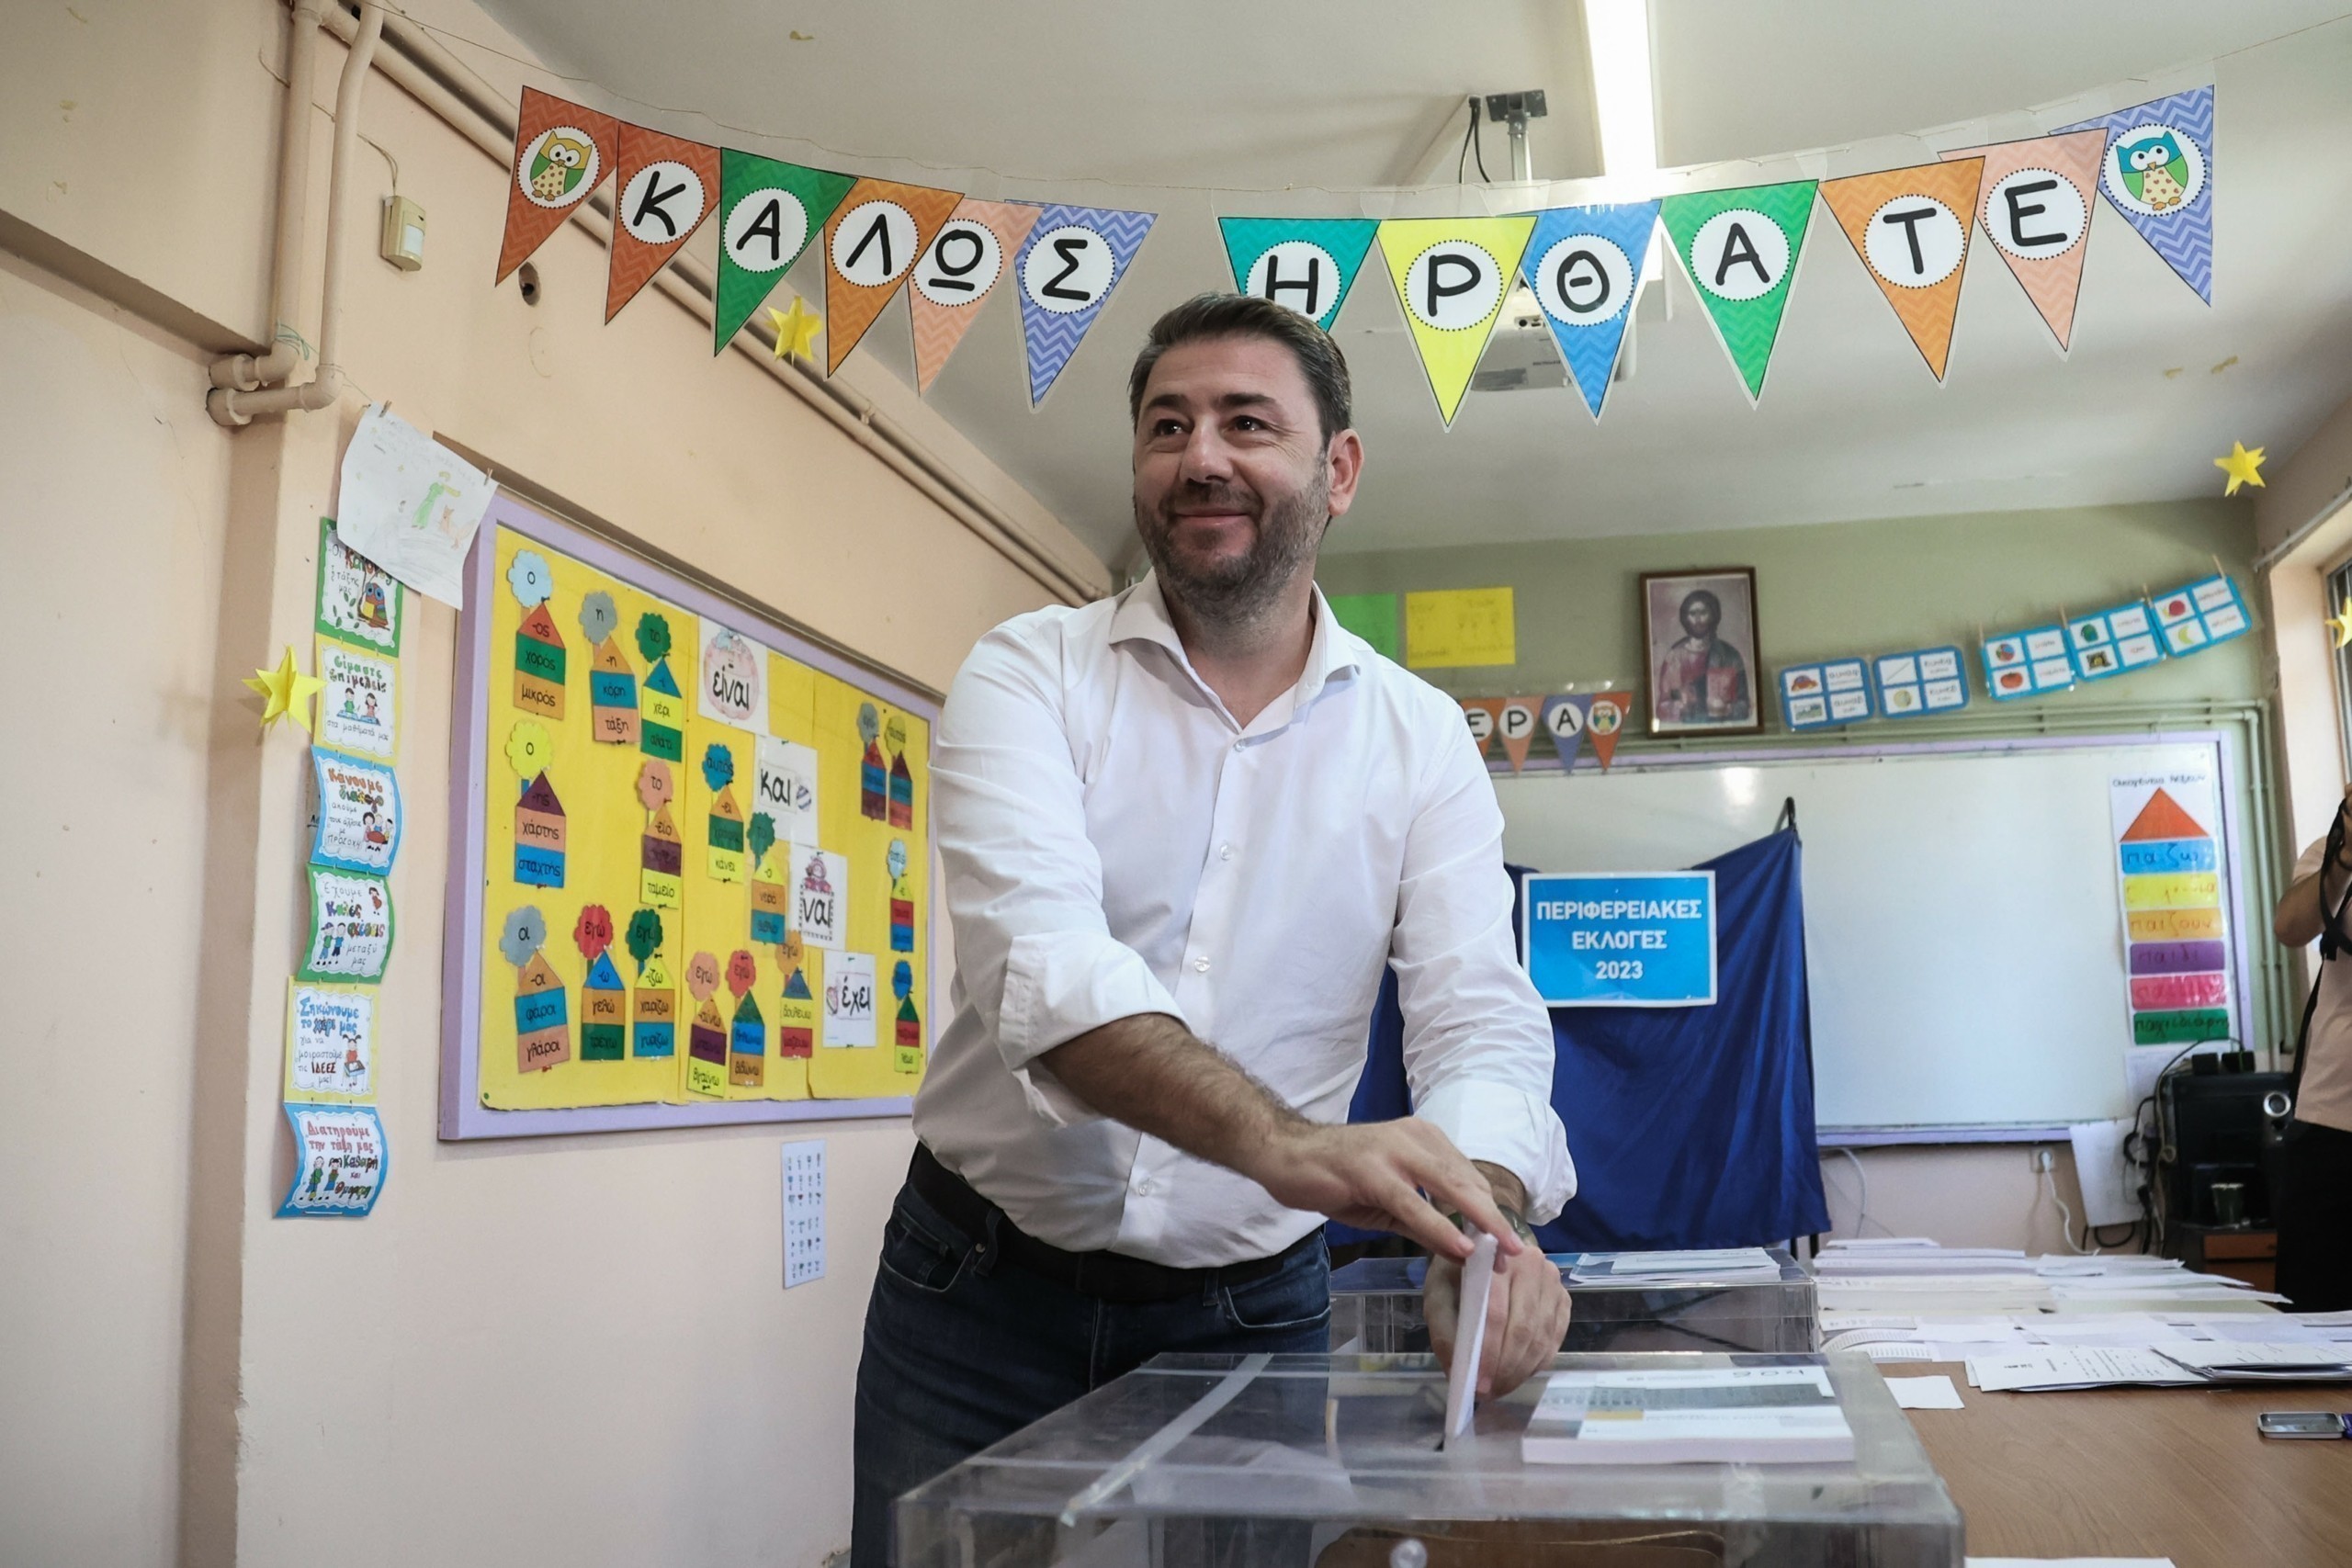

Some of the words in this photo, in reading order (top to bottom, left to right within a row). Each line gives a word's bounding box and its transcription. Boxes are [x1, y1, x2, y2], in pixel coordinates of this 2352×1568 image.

[632, 170, 1091, 302] ΚΑΛΩΣ
[1264, 179, 2068, 318] ΗΡΘΑΤΕ
[712, 665, 750, 711] είναι
[759, 768, 790, 807] και
[522, 819, 560, 840] χάρτης
[1536, 899, 1702, 920] ΠΕΡΙΦΕΡΕΙΑΚΕΣ
[1572, 930, 1668, 950] ΕΚΛΟΓΕΣ
[1595, 961, 1644, 980] 2023
[842, 976, 871, 1016] έχει
